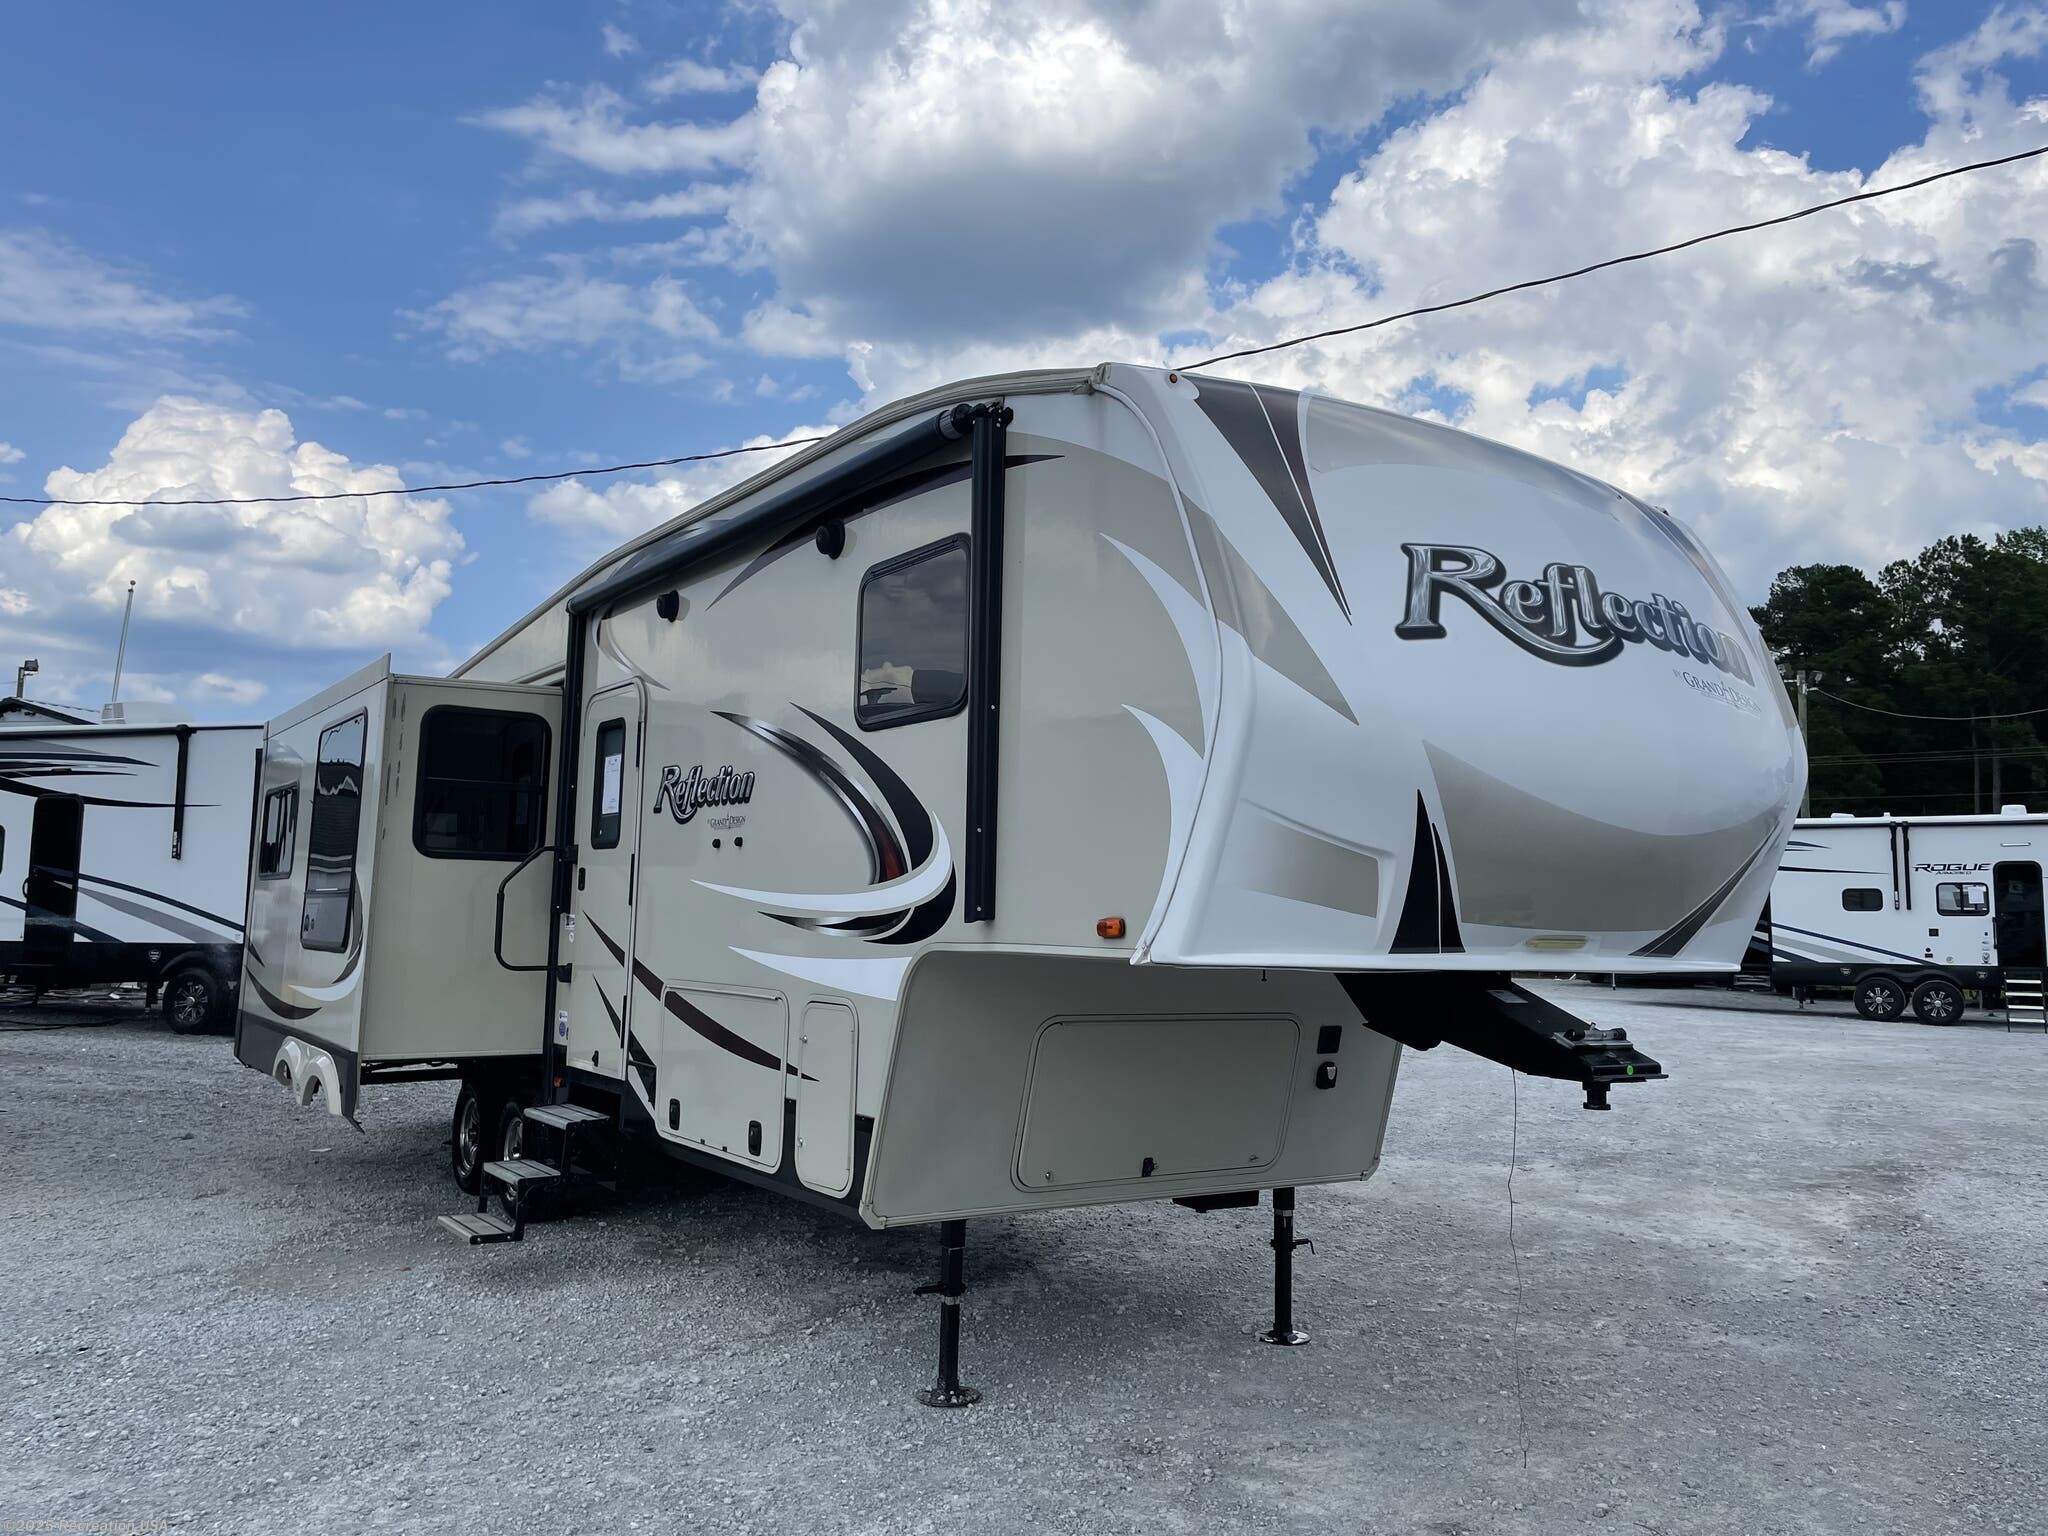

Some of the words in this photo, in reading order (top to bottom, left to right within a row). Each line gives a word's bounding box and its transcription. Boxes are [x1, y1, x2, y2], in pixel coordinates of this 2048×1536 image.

[1395, 543, 1755, 687] Reflection
[1683, 671, 1725, 697] GRAND
[653, 764, 755, 825] Reflection
[1912, 863, 1992, 873] ROGUE
